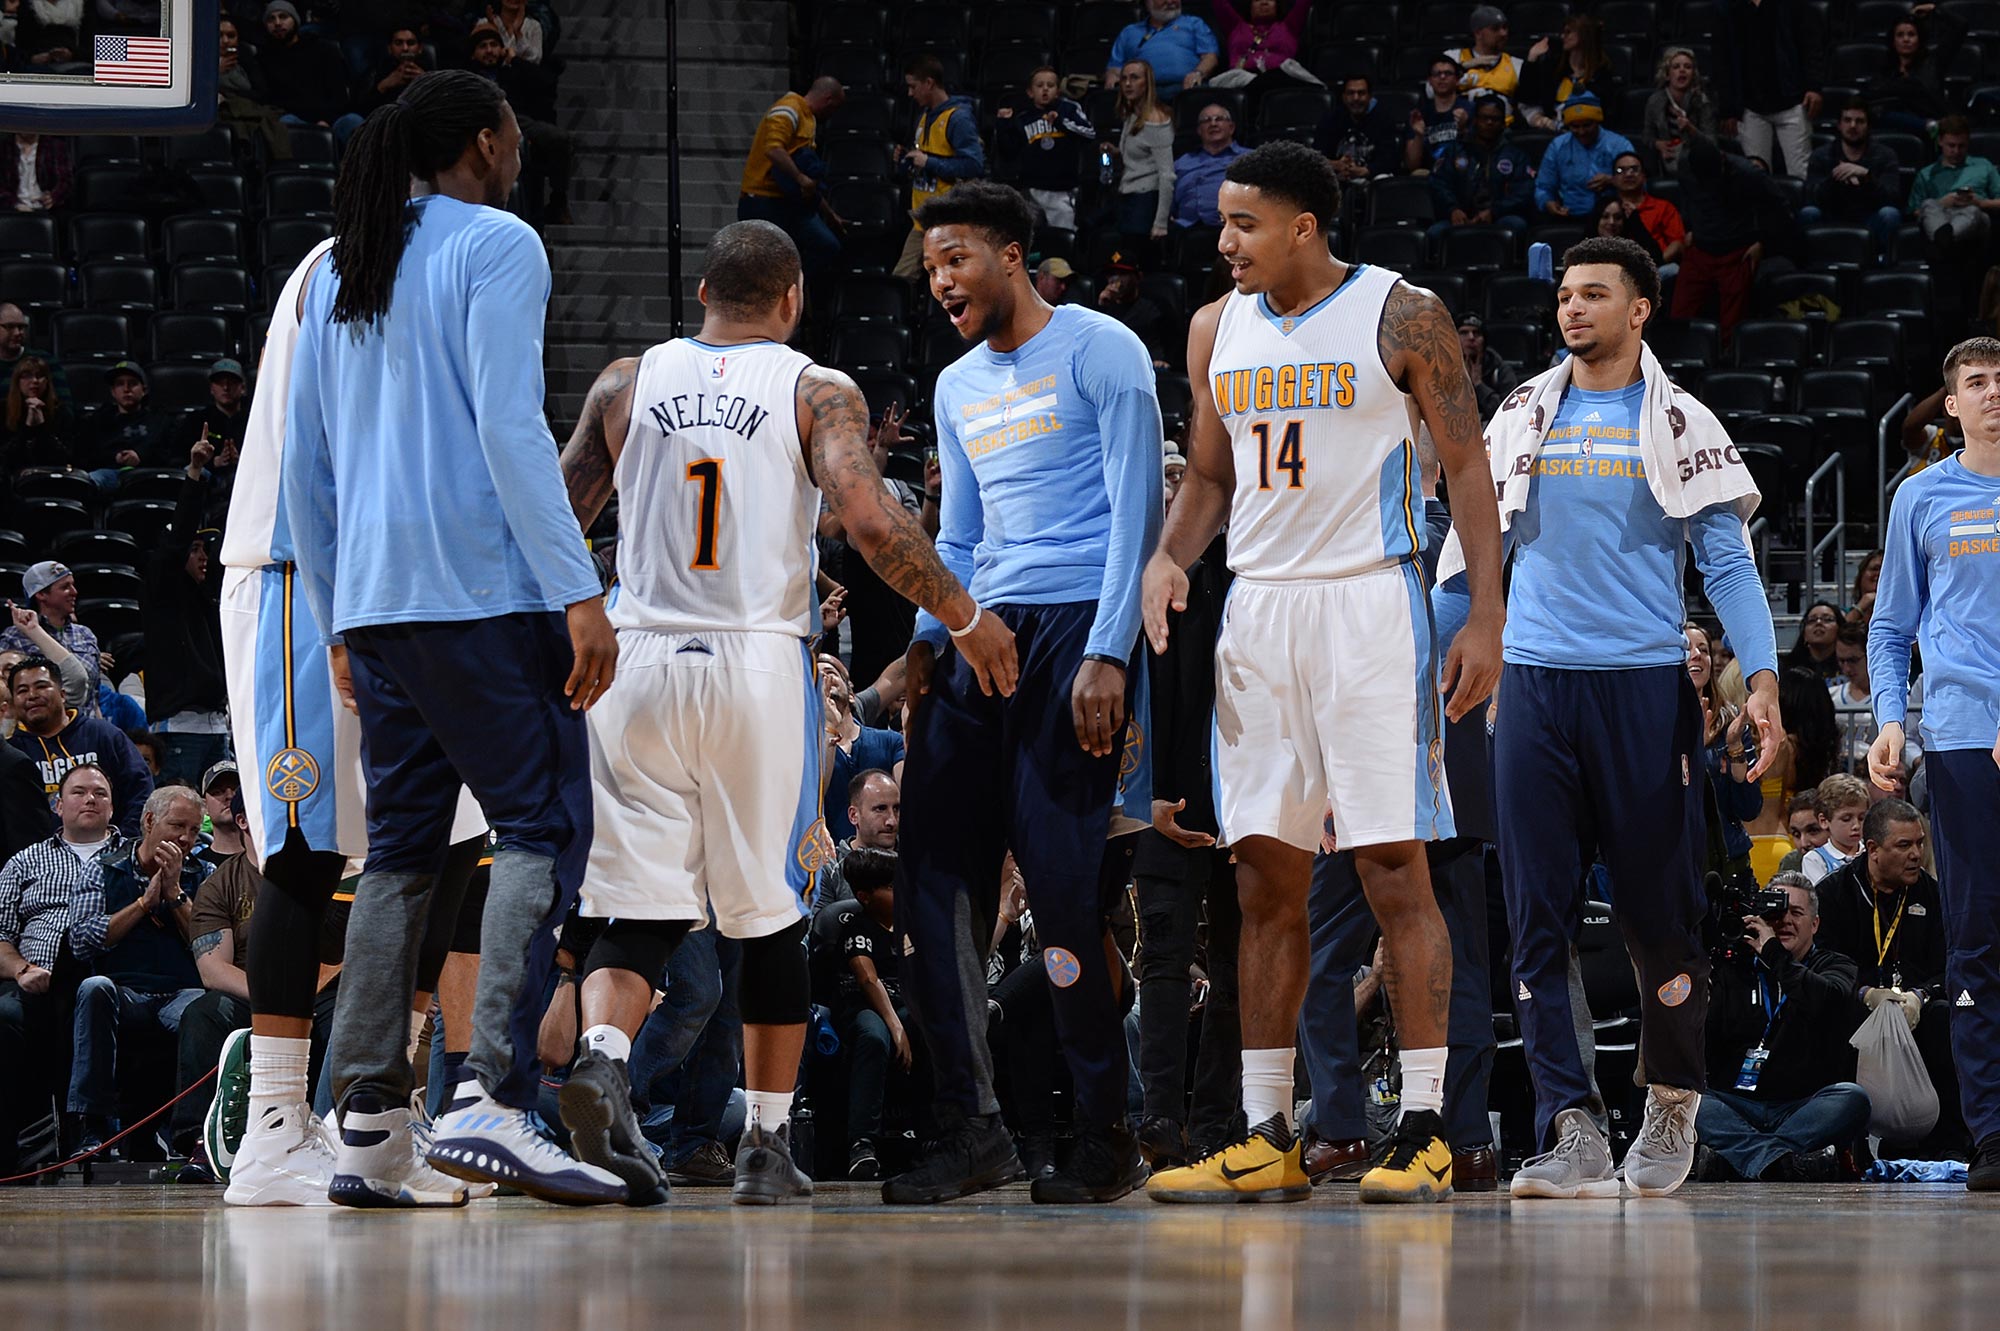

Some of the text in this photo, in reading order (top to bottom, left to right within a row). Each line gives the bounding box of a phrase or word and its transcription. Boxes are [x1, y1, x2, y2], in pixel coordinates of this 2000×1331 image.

[650, 393, 769, 441] NELSON
[1214, 361, 1358, 419] NUGGETS
[966, 411, 1064, 461] BASKETBALL
[1251, 419, 1307, 491] 14
[686, 458, 726, 571] 1
